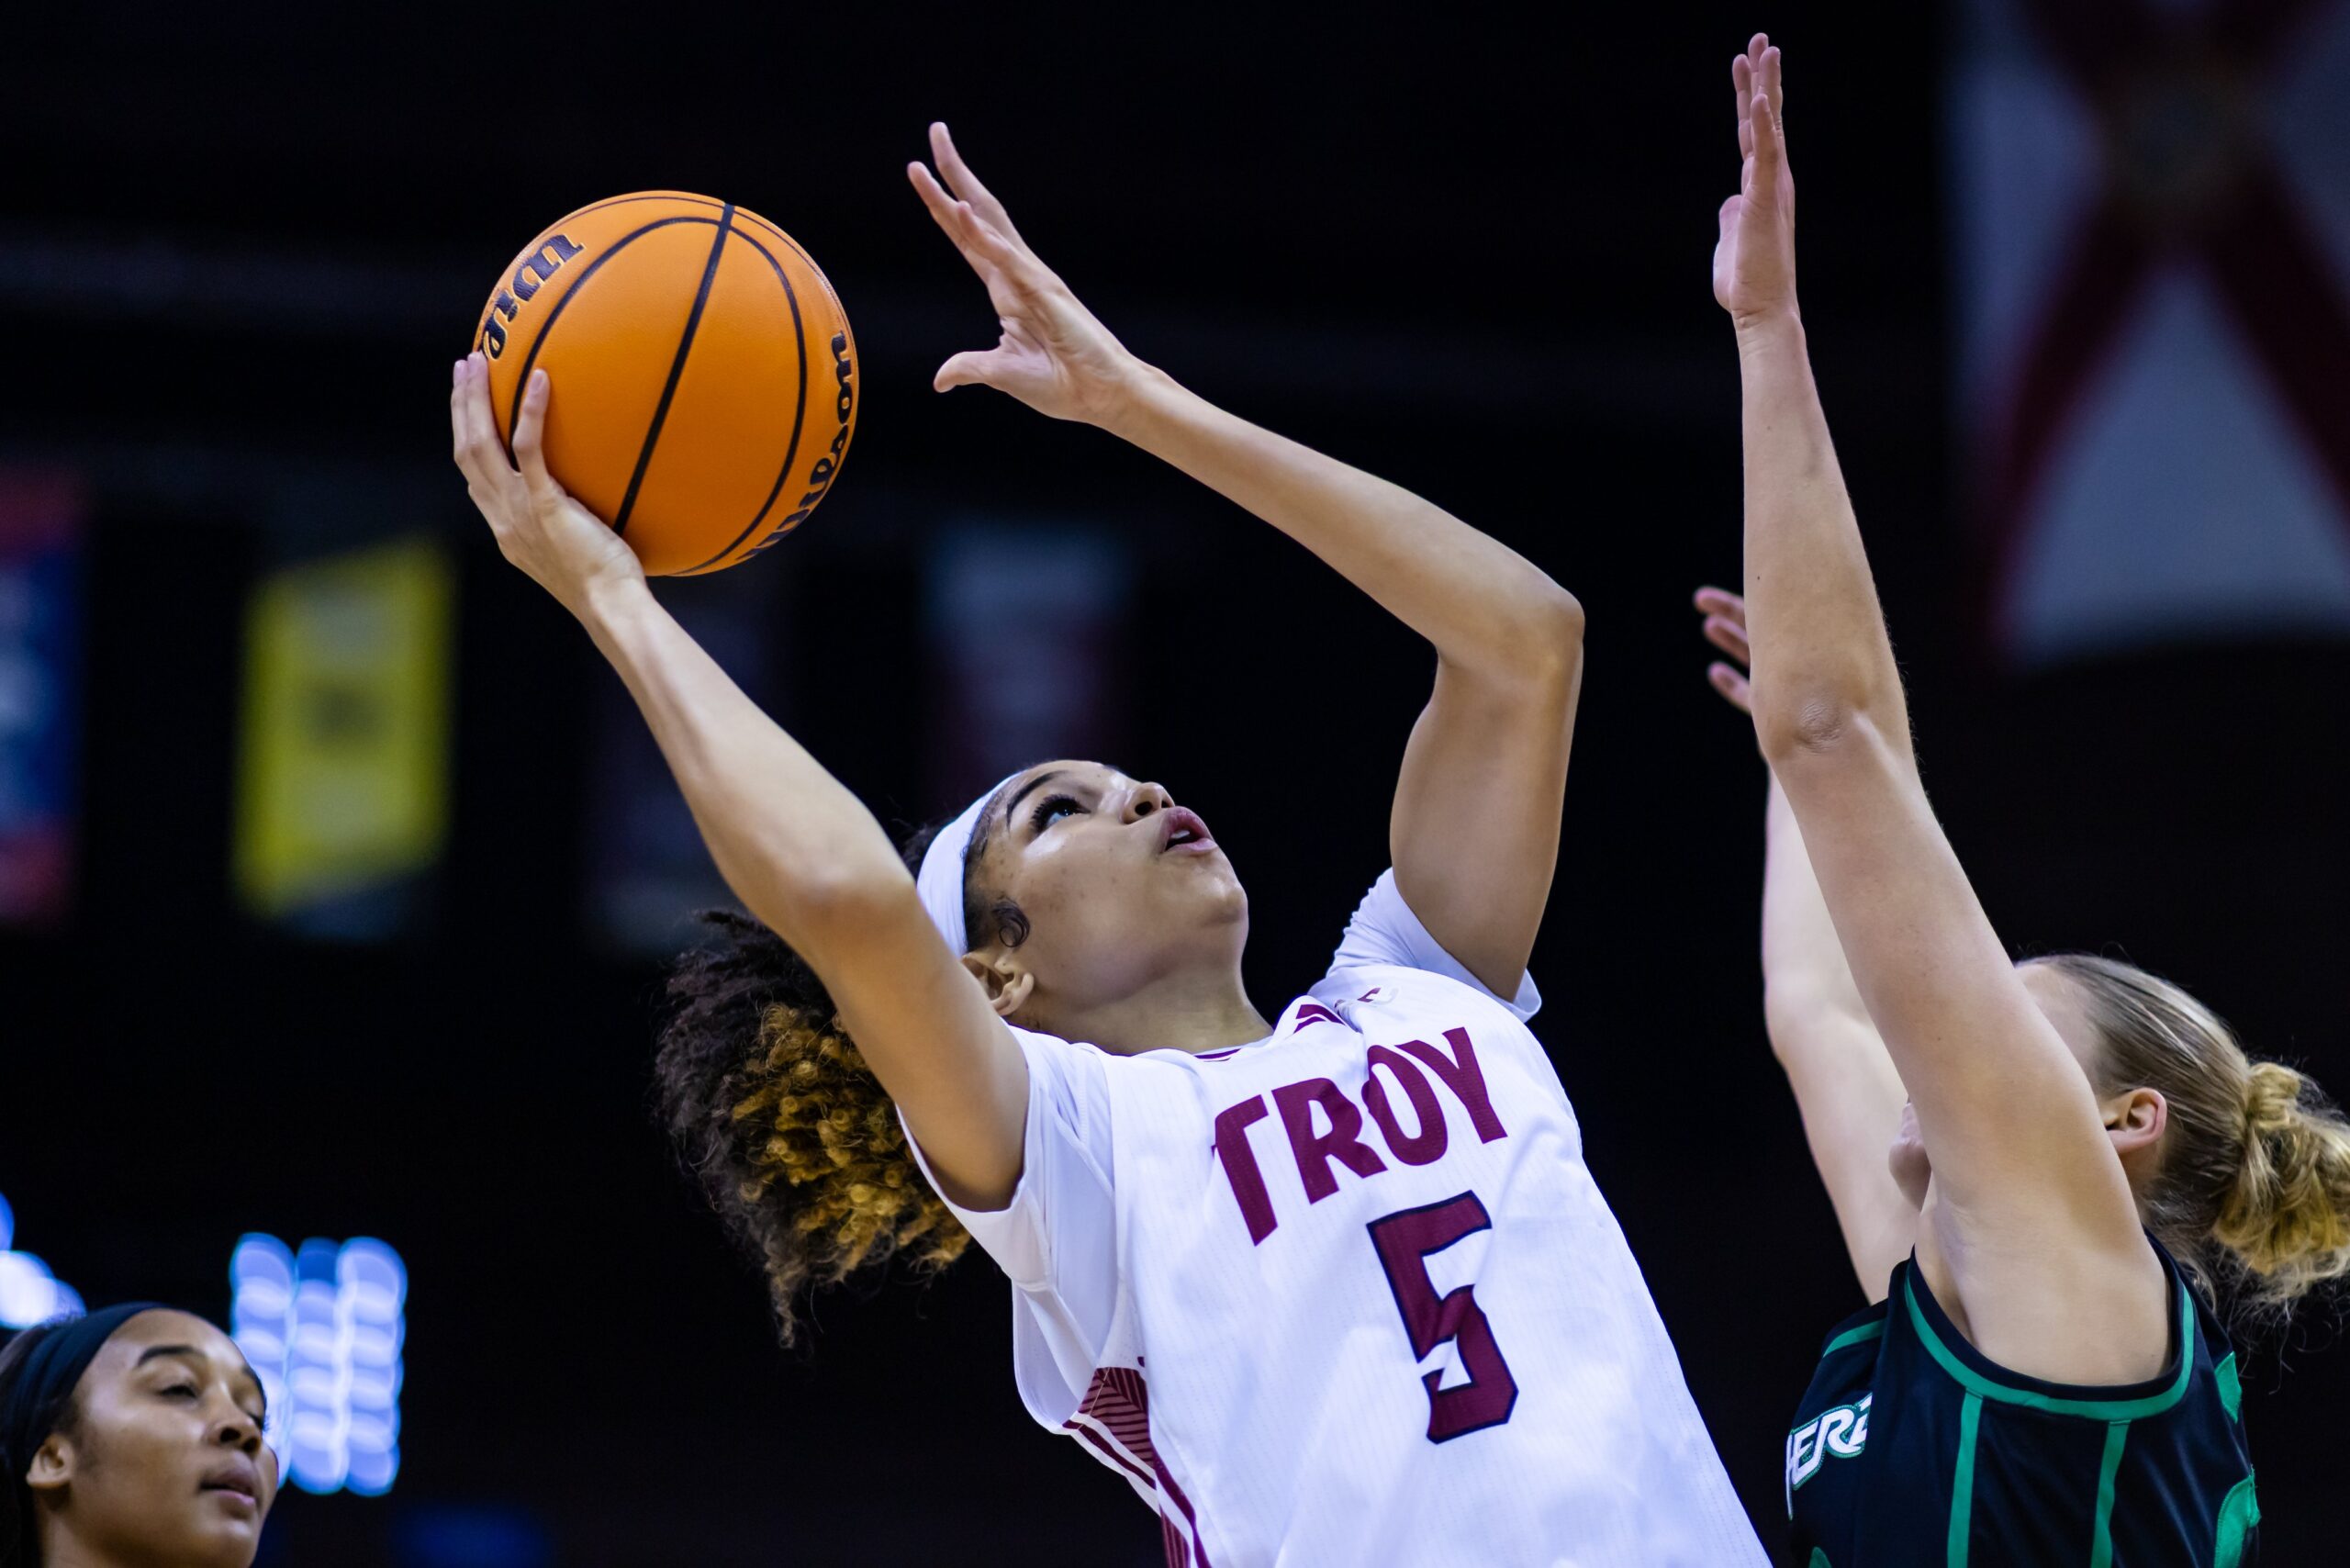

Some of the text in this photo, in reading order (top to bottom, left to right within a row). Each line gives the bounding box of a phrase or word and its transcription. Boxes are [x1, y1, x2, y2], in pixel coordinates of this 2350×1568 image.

[477, 234, 586, 359] Wil
[735, 330, 853, 560] Wilson
[1212, 1026, 1507, 1246] TROY
[1366, 1190, 1518, 1444] 5
[1785, 1393, 1874, 1521] ER
